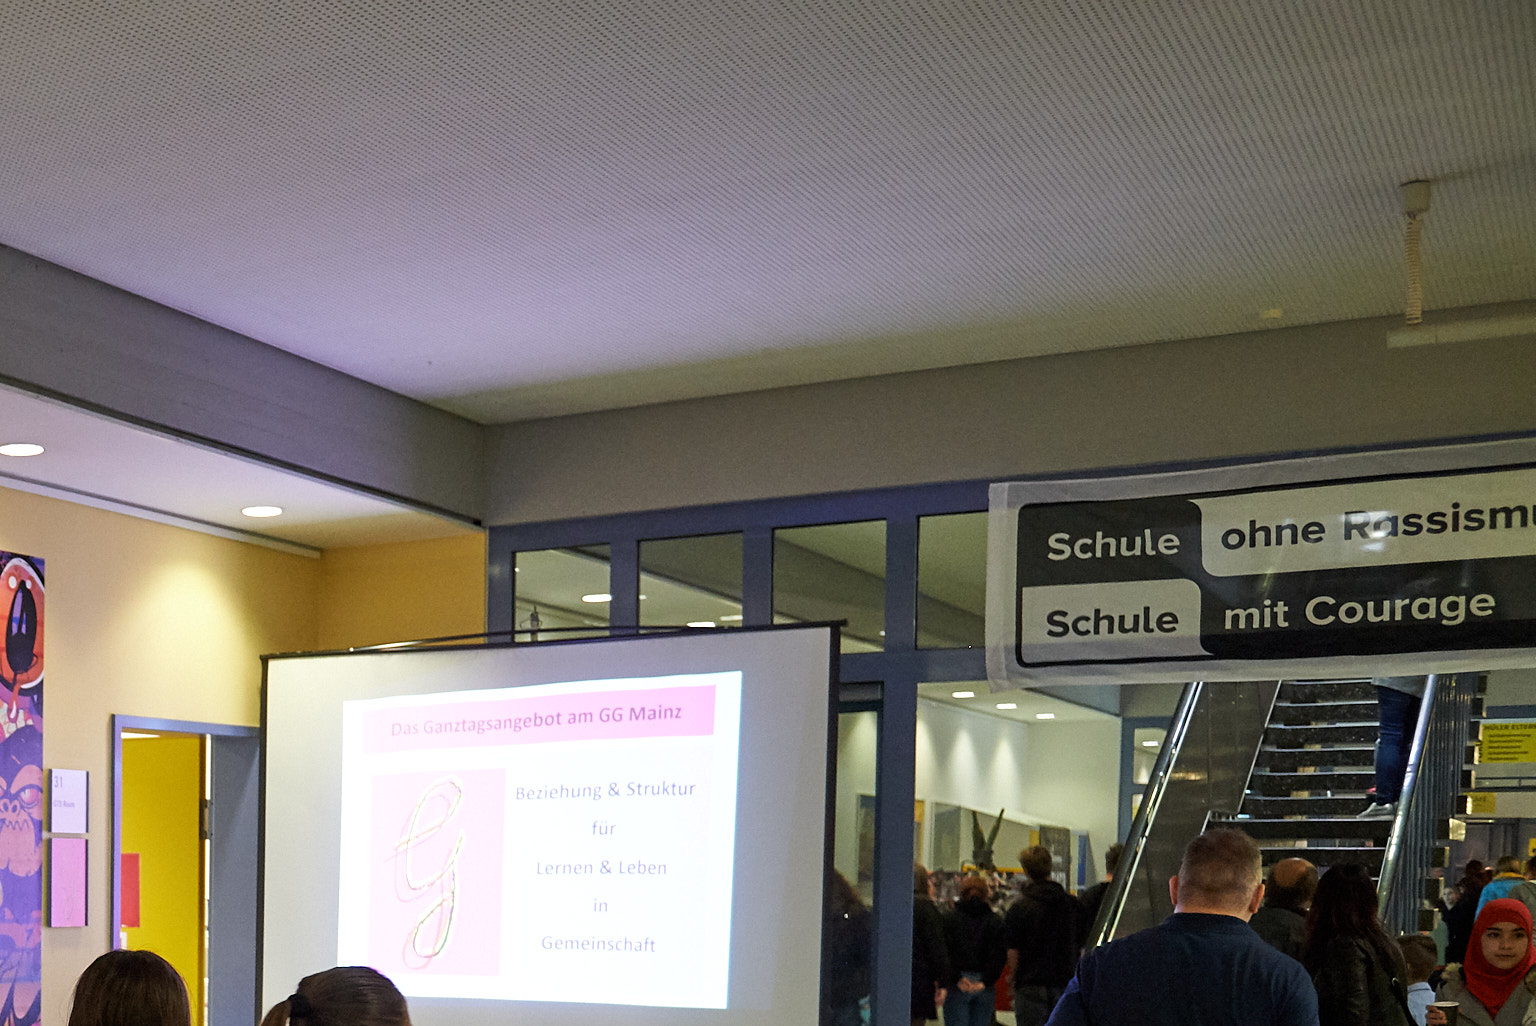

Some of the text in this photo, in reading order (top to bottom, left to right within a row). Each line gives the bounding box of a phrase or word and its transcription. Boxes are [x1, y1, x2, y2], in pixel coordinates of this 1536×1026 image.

[1047, 502, 1536, 561] Schule ohne Rassism
[1046, 591, 1496, 638] Schule mit Courage
[391, 704, 683, 737] Das Ganztagsangebot am GG Mainz
[515, 780, 696, 801] Beziehung & Struktur
[591, 820, 617, 837] für
[536, 860, 667, 876] Lernen & Leben
[593, 898, 609, 914] in
[541, 936, 656, 954] Gemeinschaft
